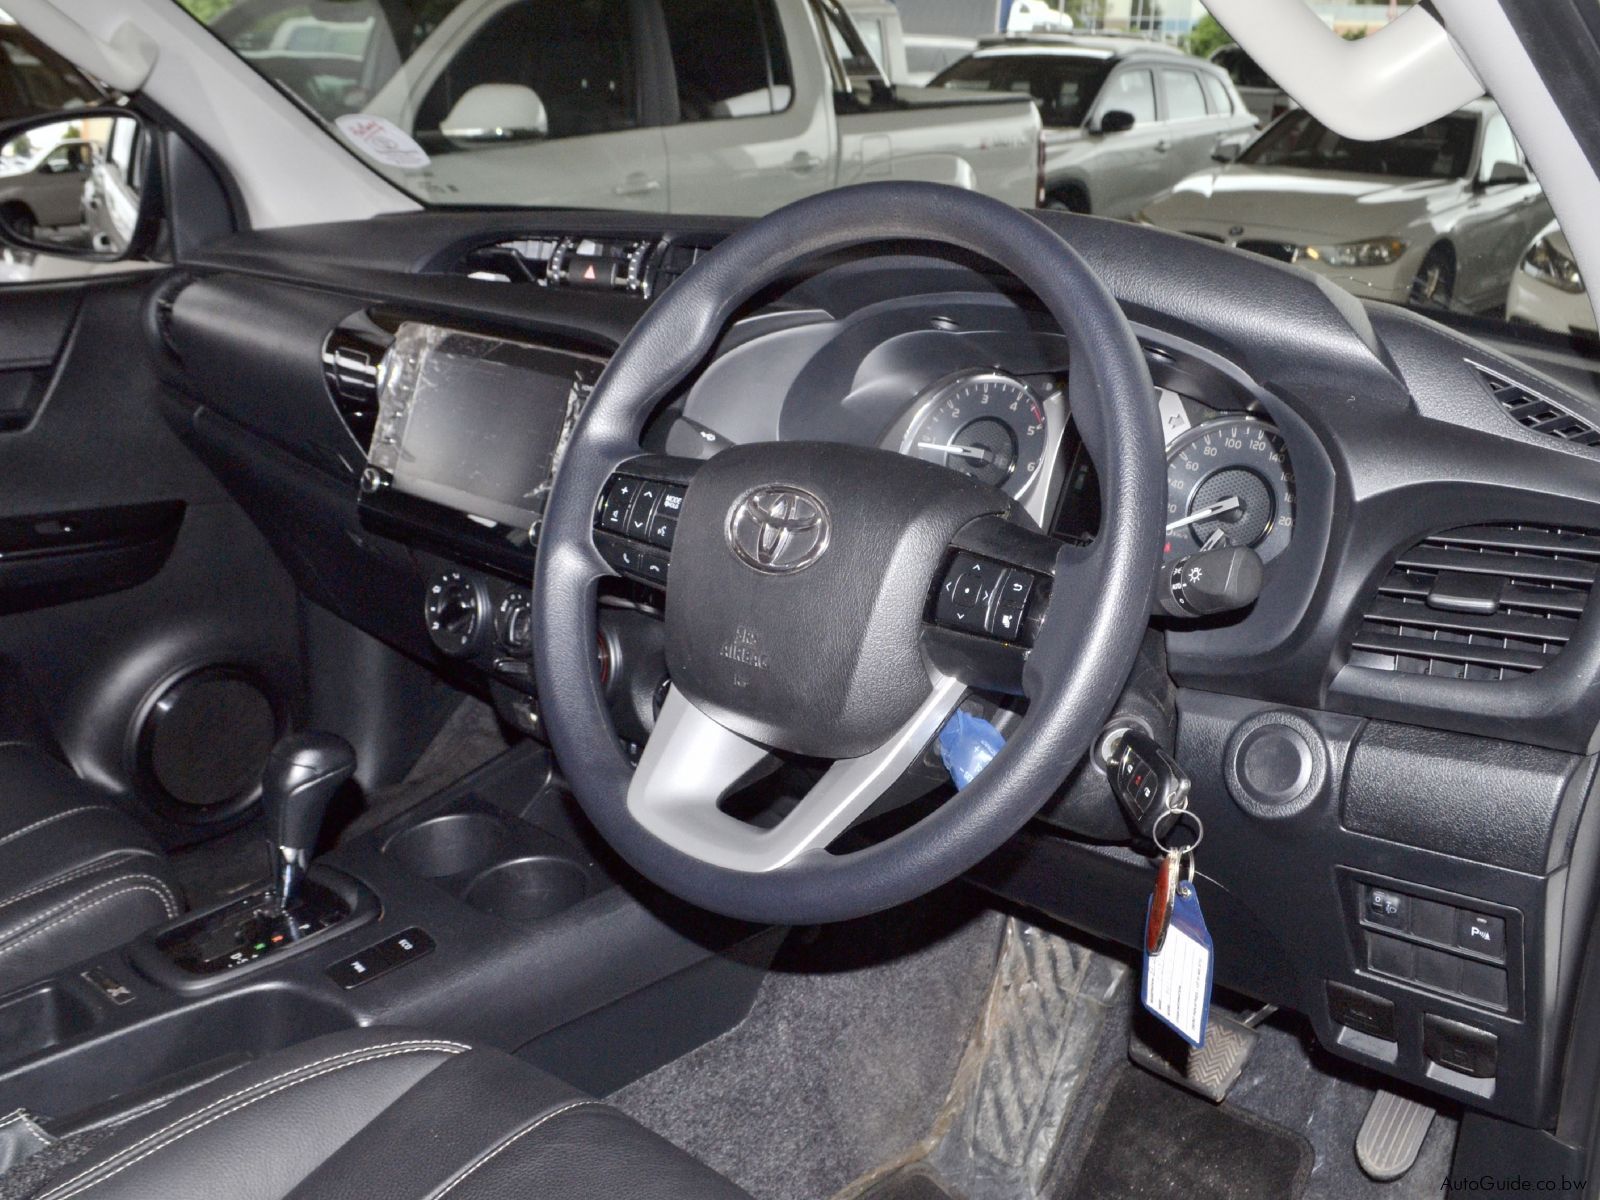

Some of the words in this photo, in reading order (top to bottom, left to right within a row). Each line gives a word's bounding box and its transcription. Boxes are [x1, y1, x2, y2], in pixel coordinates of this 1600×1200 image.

[981, 394, 990, 404] 3
[1009, 402, 1018, 411] 4
[952, 408, 960, 418] 2
[1027, 426, 1035, 435] 5
[1224, 437, 1243, 450] 100
[1249, 439, 1267, 451] 120
[1203, 446, 1218, 457] 80
[1027, 461, 1035, 471] 6
[1185, 461, 1200, 472] 60
[1170, 479, 1185, 490] 40
[1470, 926, 1480, 937] P
